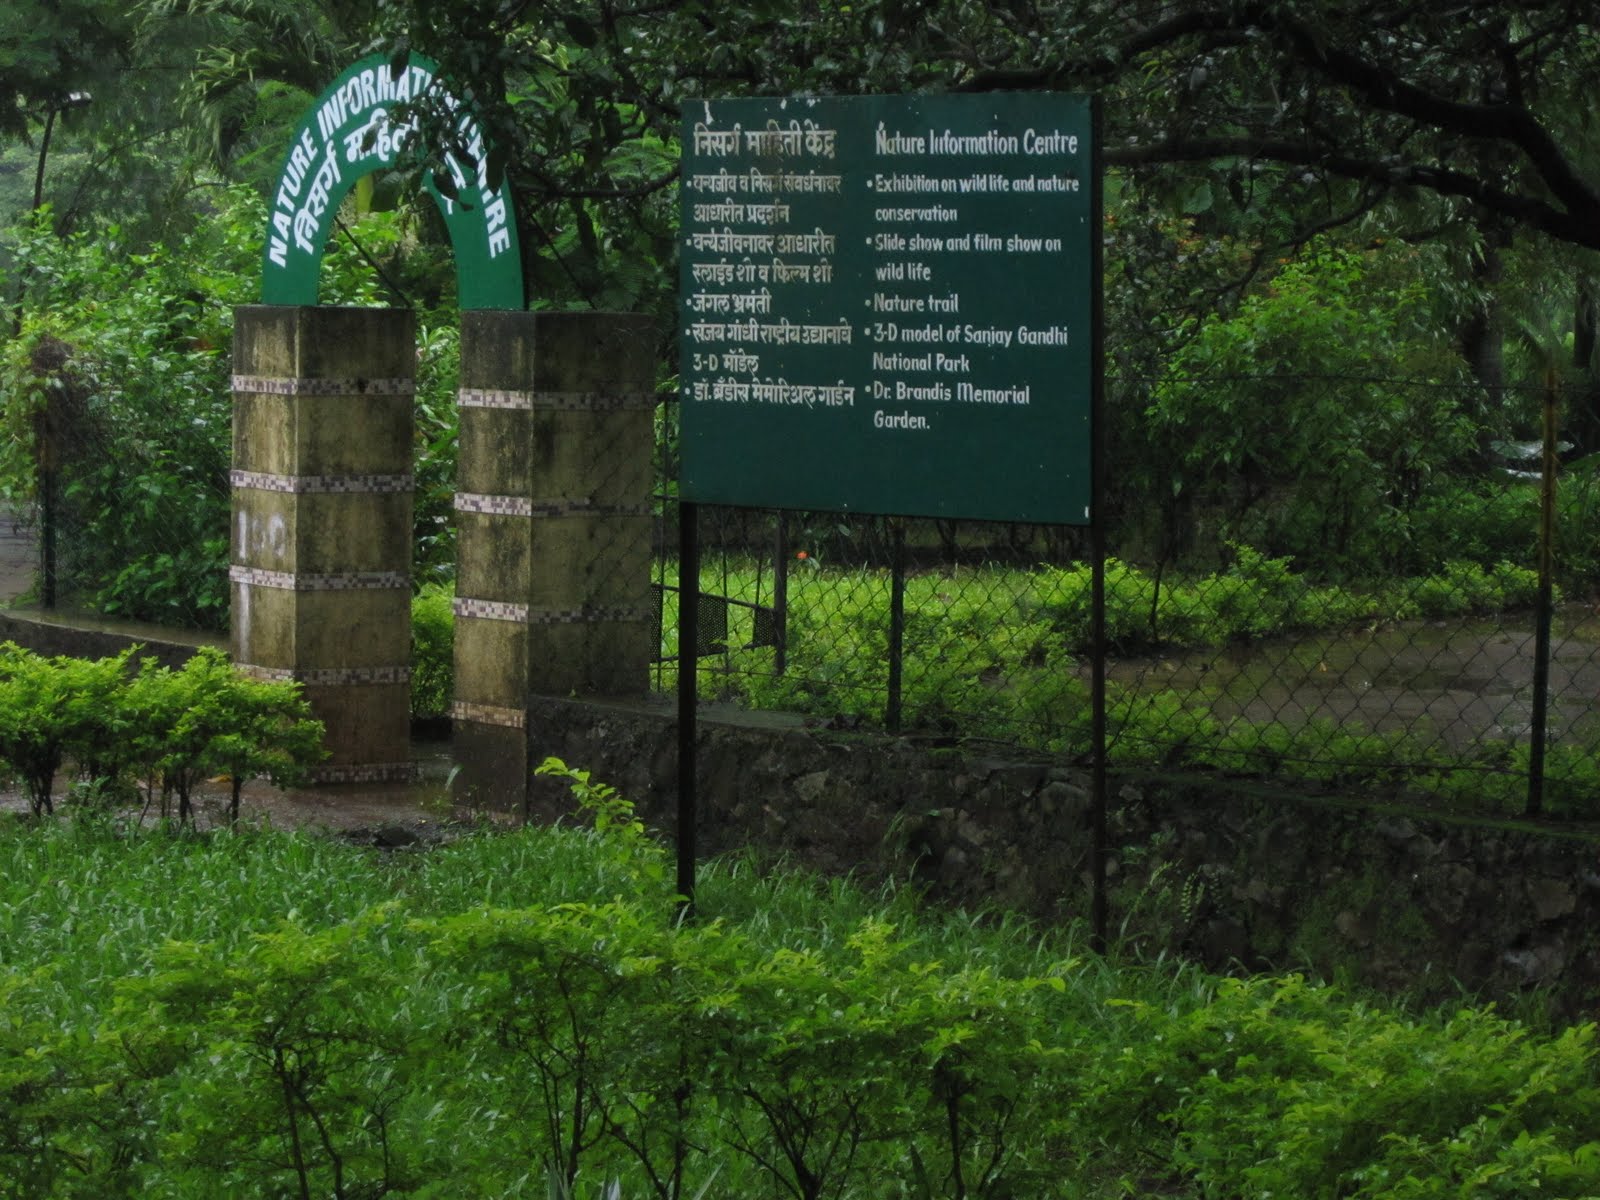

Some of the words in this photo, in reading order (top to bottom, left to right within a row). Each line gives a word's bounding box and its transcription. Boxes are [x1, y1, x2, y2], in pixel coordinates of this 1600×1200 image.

[694, 121, 741, 156] निसर्ग
[745, 119, 802, 156] माहिती
[804, 118, 837, 159] केंद्र
[875, 127, 925, 155] Nature
[930, 129, 1018, 155] Information
[1023, 128, 1078, 155] Centre
[875, 174, 938, 193] Exhibition
[941, 179, 956, 192] on
[959, 175, 987, 192] wild
[989, 175, 1009, 191] life
[1013, 175, 1034, 192] and
[1037, 177, 1079, 192] nature
[269, 127, 319, 269] NATURE
[294, 140, 342, 256] निसर्ग
[875, 205, 957, 221] conservation
[875, 234, 905, 251] Slide
[909, 234, 943, 251] show
[947, 234, 970, 251] and
[974, 235, 1002, 251] film
[1007, 235, 1042, 251] show
[1045, 238, 1061, 251] on
[736, 257, 755, 283] शो
[758, 265, 769, 283] व
[772, 258, 810, 283] फिल्म
[812, 258, 832, 283] शो
[876, 263, 903, 281] wild
[908, 263, 931, 281] life
[693, 289, 729, 315] जंगल
[874, 293, 924, 312] Nature
[928, 293, 959, 313] trail
[692, 319, 725, 342] संजय
[727, 318, 759, 342] गांधी
[874, 323, 897, 342] 3-D
[902, 324, 943, 343] model
[947, 325, 959, 343] of
[964, 325, 1012, 348] Sanjay
[1018, 326, 1068, 345] Gandhi
[693, 354, 718, 371] 3-D
[723, 348, 759, 376] मॉडेल
[873, 352, 932, 371] National
[936, 353, 970, 372] Park
[818, 379, 854, 406] गार्डन
[874, 381, 891, 399] Dr.
[896, 382, 951, 401] Brandis
[957, 383, 1030, 404] Memorial
[874, 410, 930, 429] Garden.
